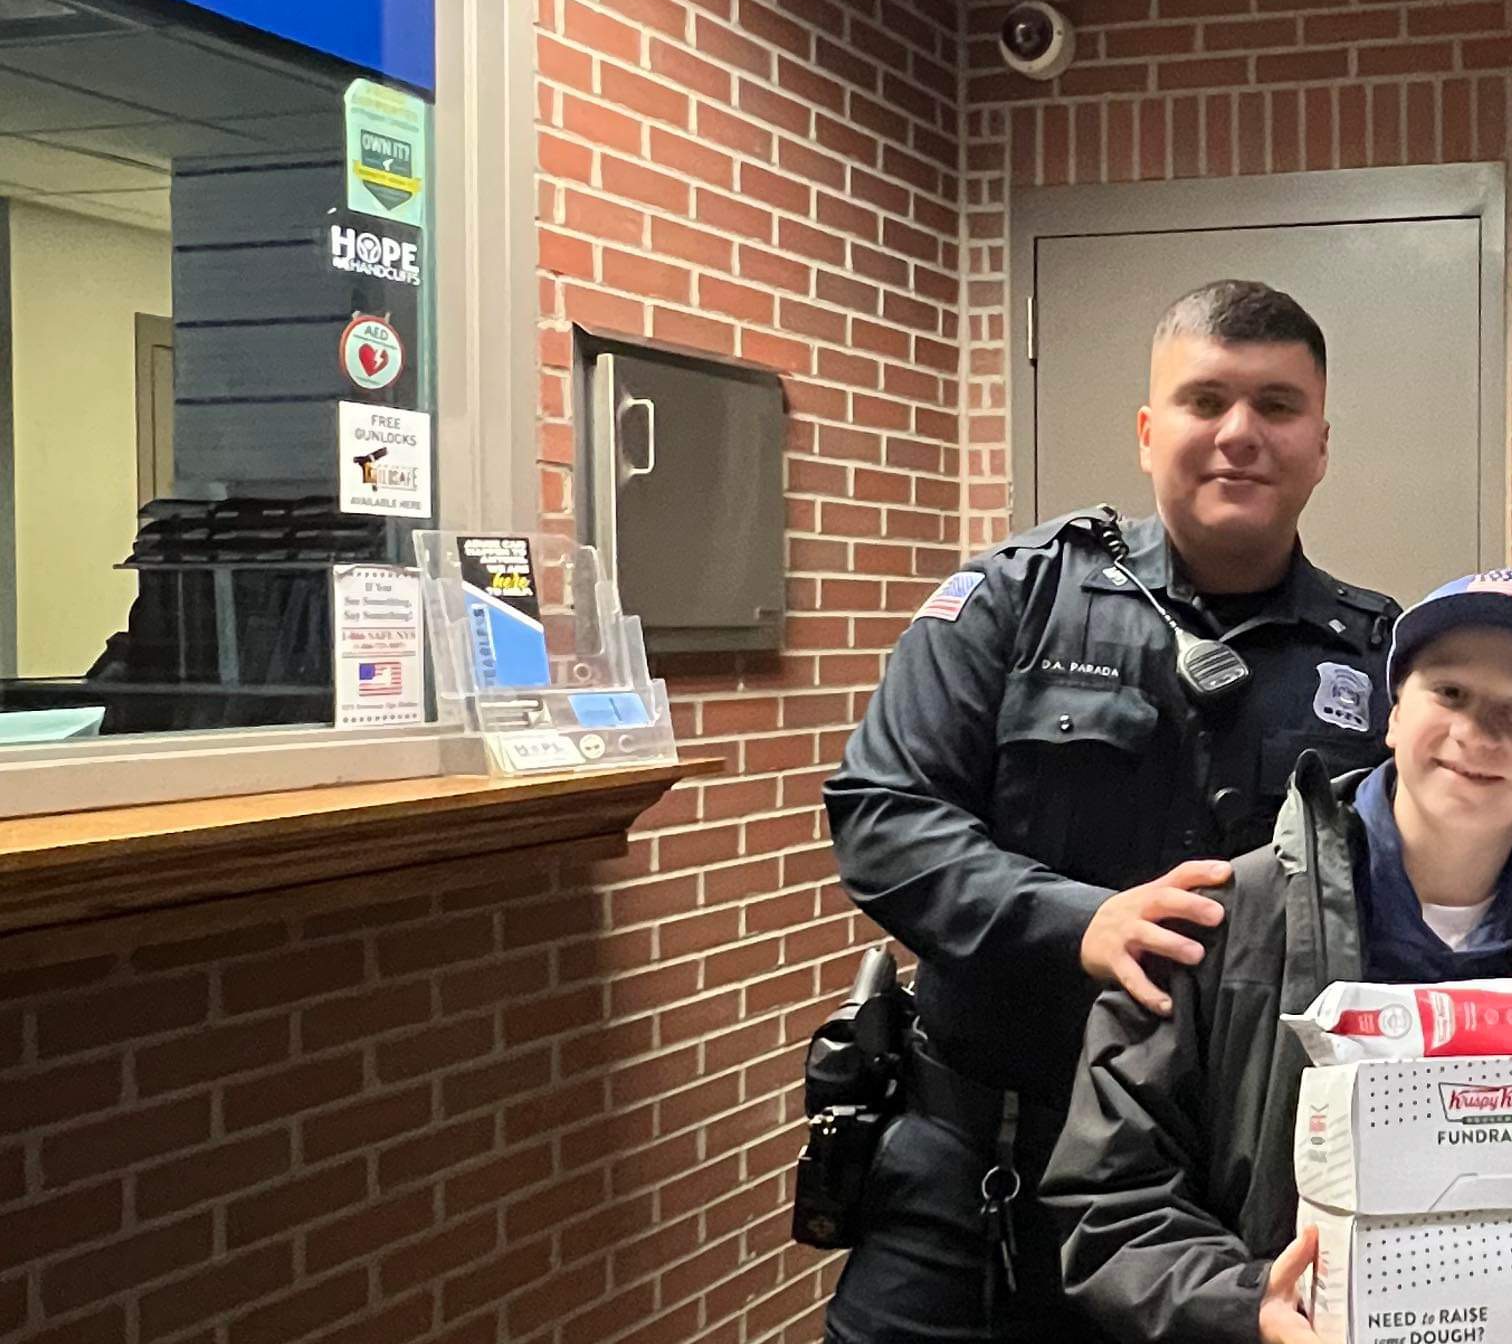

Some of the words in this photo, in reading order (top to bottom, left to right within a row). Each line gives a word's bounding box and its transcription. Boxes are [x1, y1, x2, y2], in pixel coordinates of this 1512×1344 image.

[331, 225, 420, 273] HOPE
[364, 325, 389, 341] AED
[371, 414, 401, 430] FREE
[354, 427, 417, 447] GUNLOCKS
[1070, 661, 1120, 677] PARADA
[1368, 1311, 1416, 1329] NEED
[1422, 1311, 1435, 1326] to
[1439, 1306, 1488, 1324] RAISE
